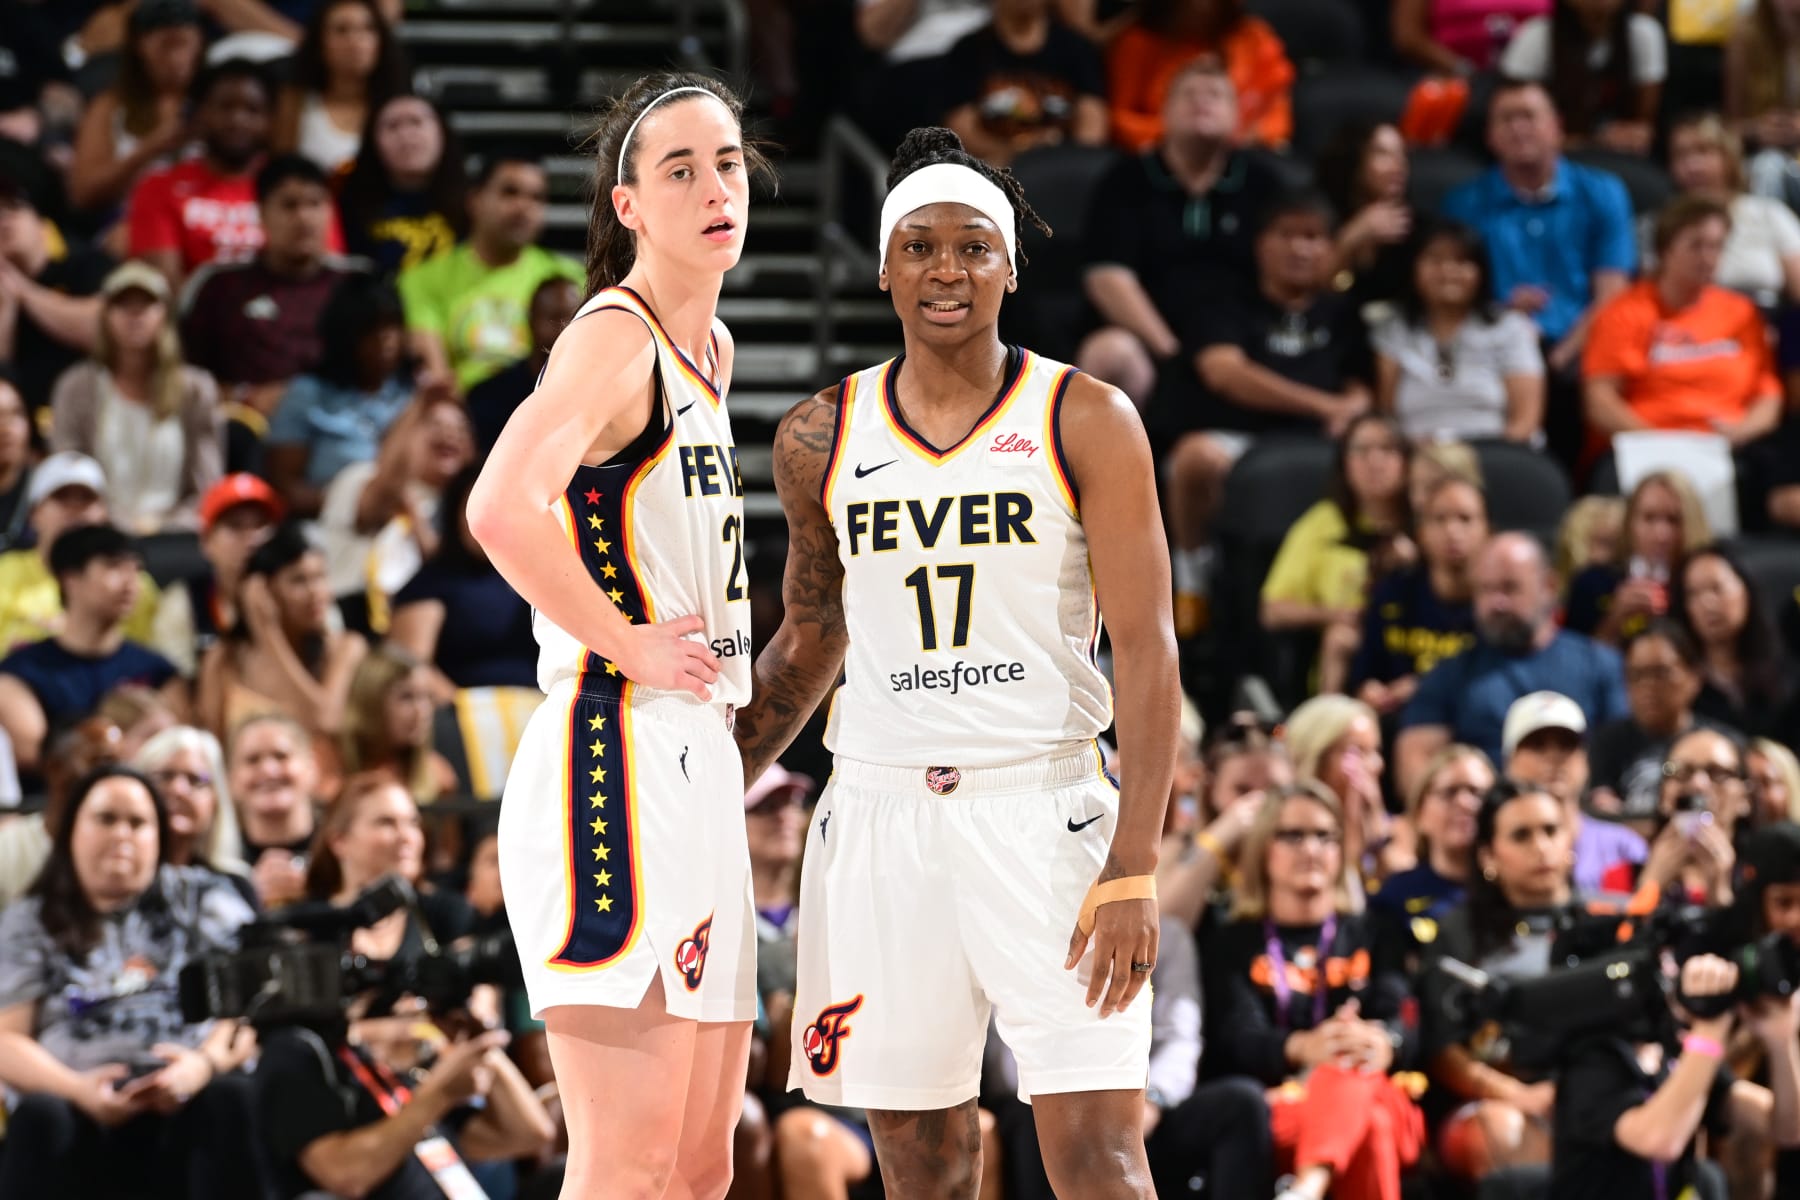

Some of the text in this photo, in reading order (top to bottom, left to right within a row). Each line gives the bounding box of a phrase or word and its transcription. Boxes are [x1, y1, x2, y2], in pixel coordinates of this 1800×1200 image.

[990, 433, 1039, 458] Lilly
[847, 491, 1039, 557] FEVER
[722, 514, 751, 602] 2
[904, 562, 976, 652] 17
[890, 661, 1025, 694] salesforce
